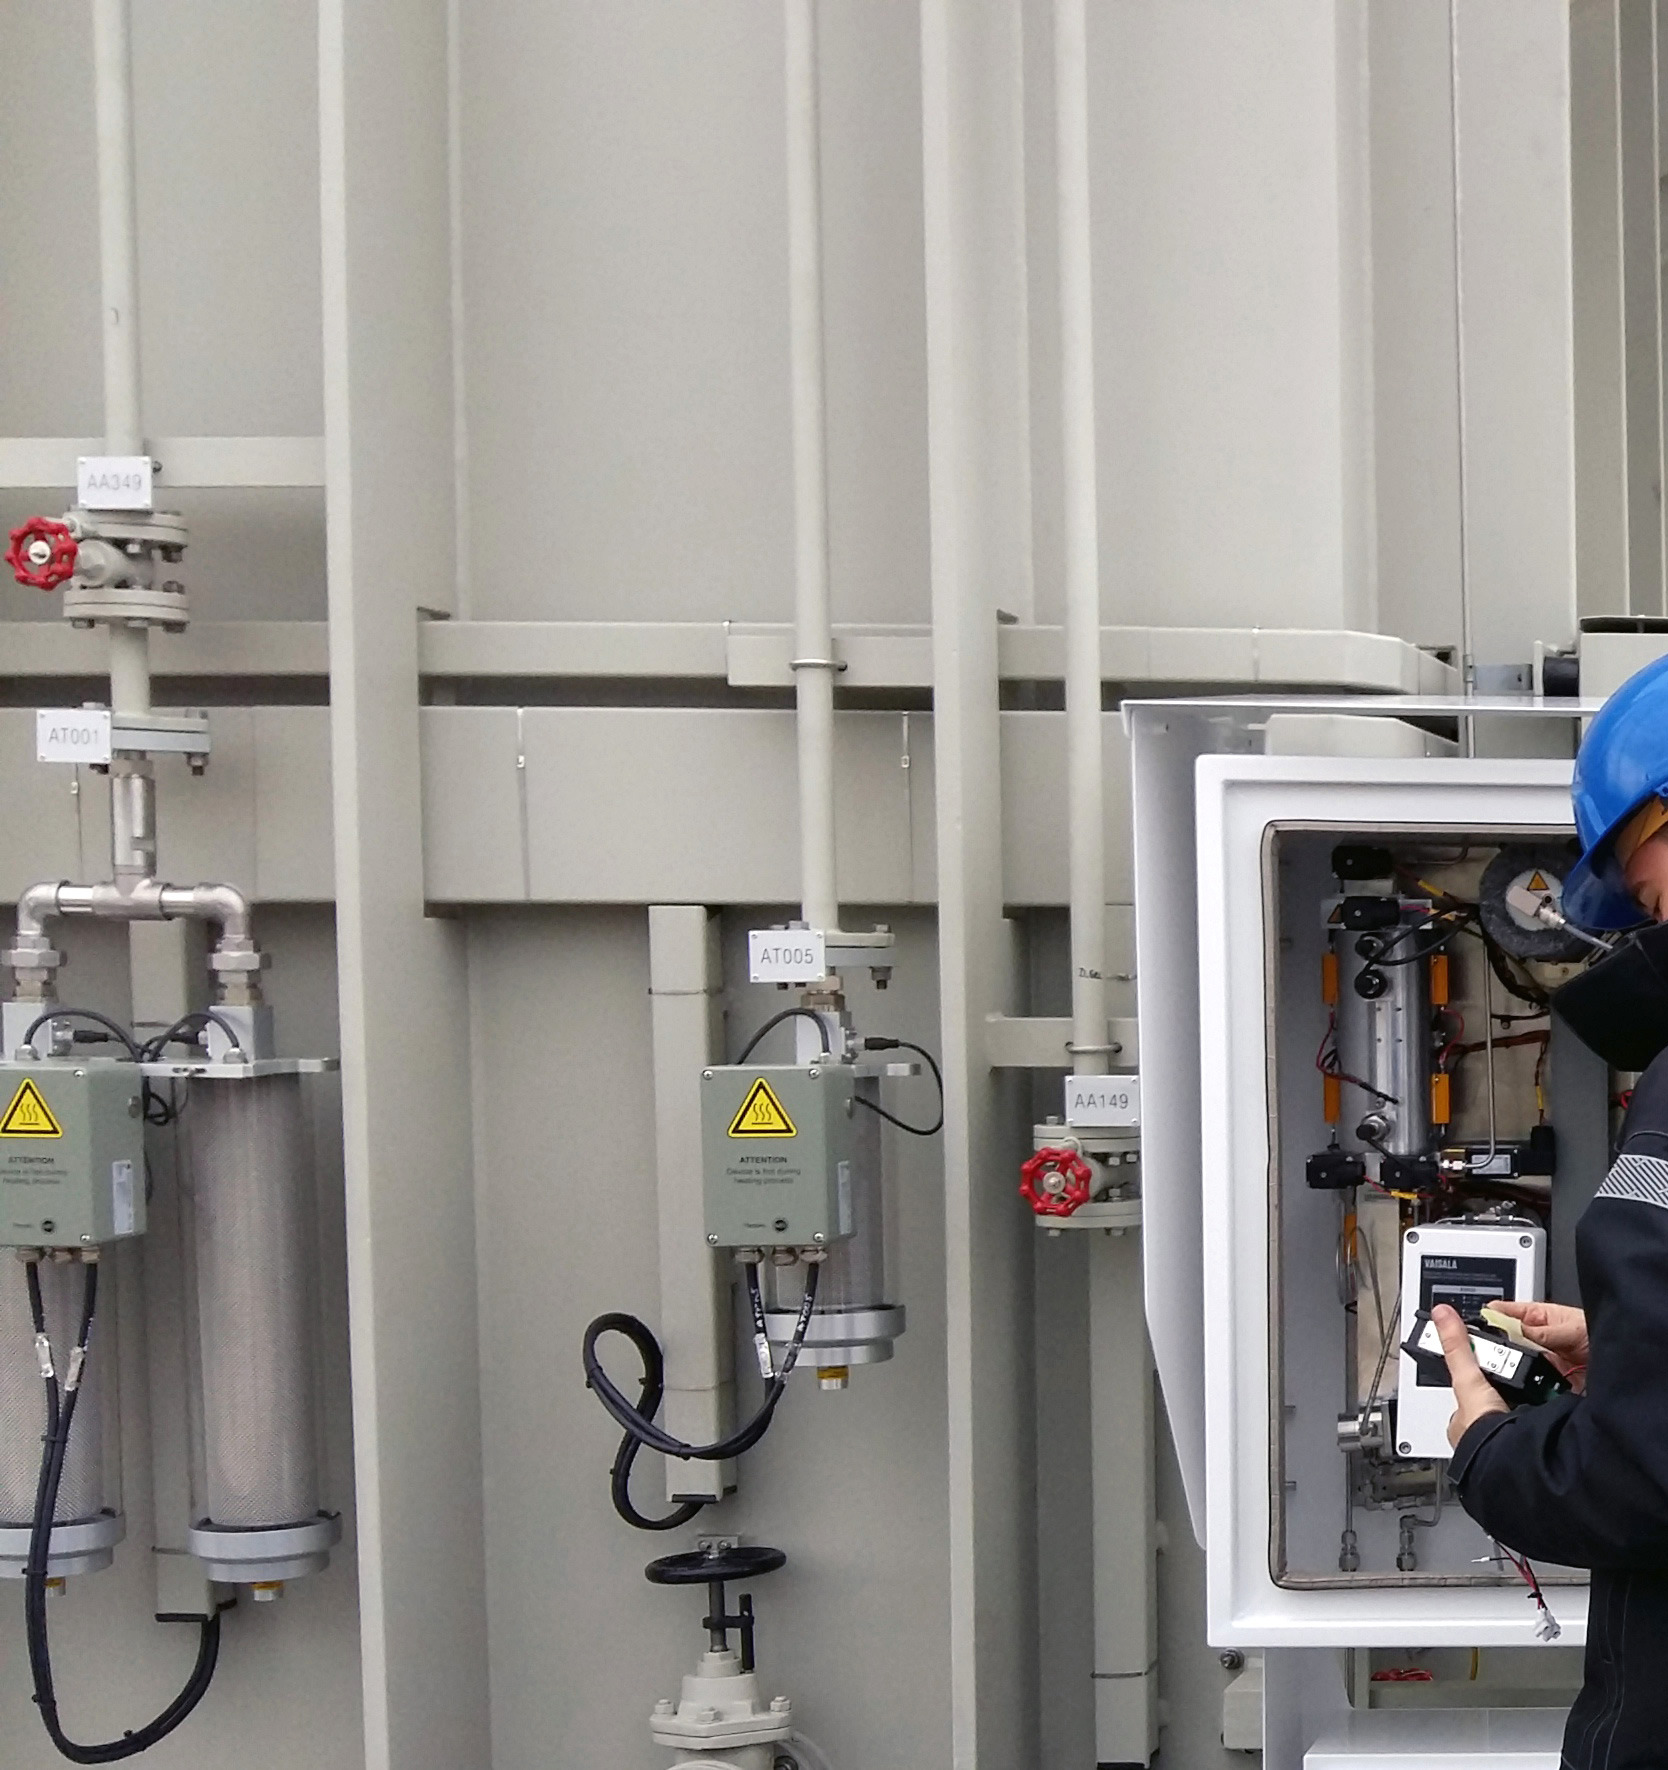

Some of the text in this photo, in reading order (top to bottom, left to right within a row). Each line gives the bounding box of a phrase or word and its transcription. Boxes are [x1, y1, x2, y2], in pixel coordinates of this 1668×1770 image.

[87, 474, 142, 491] AA349
[49, 727, 98, 745] AT001
[760, 948, 814, 964] AT005
[1074, 1093, 1129, 1109] AA149
[1424, 1259, 1457, 1269] VAISALA
